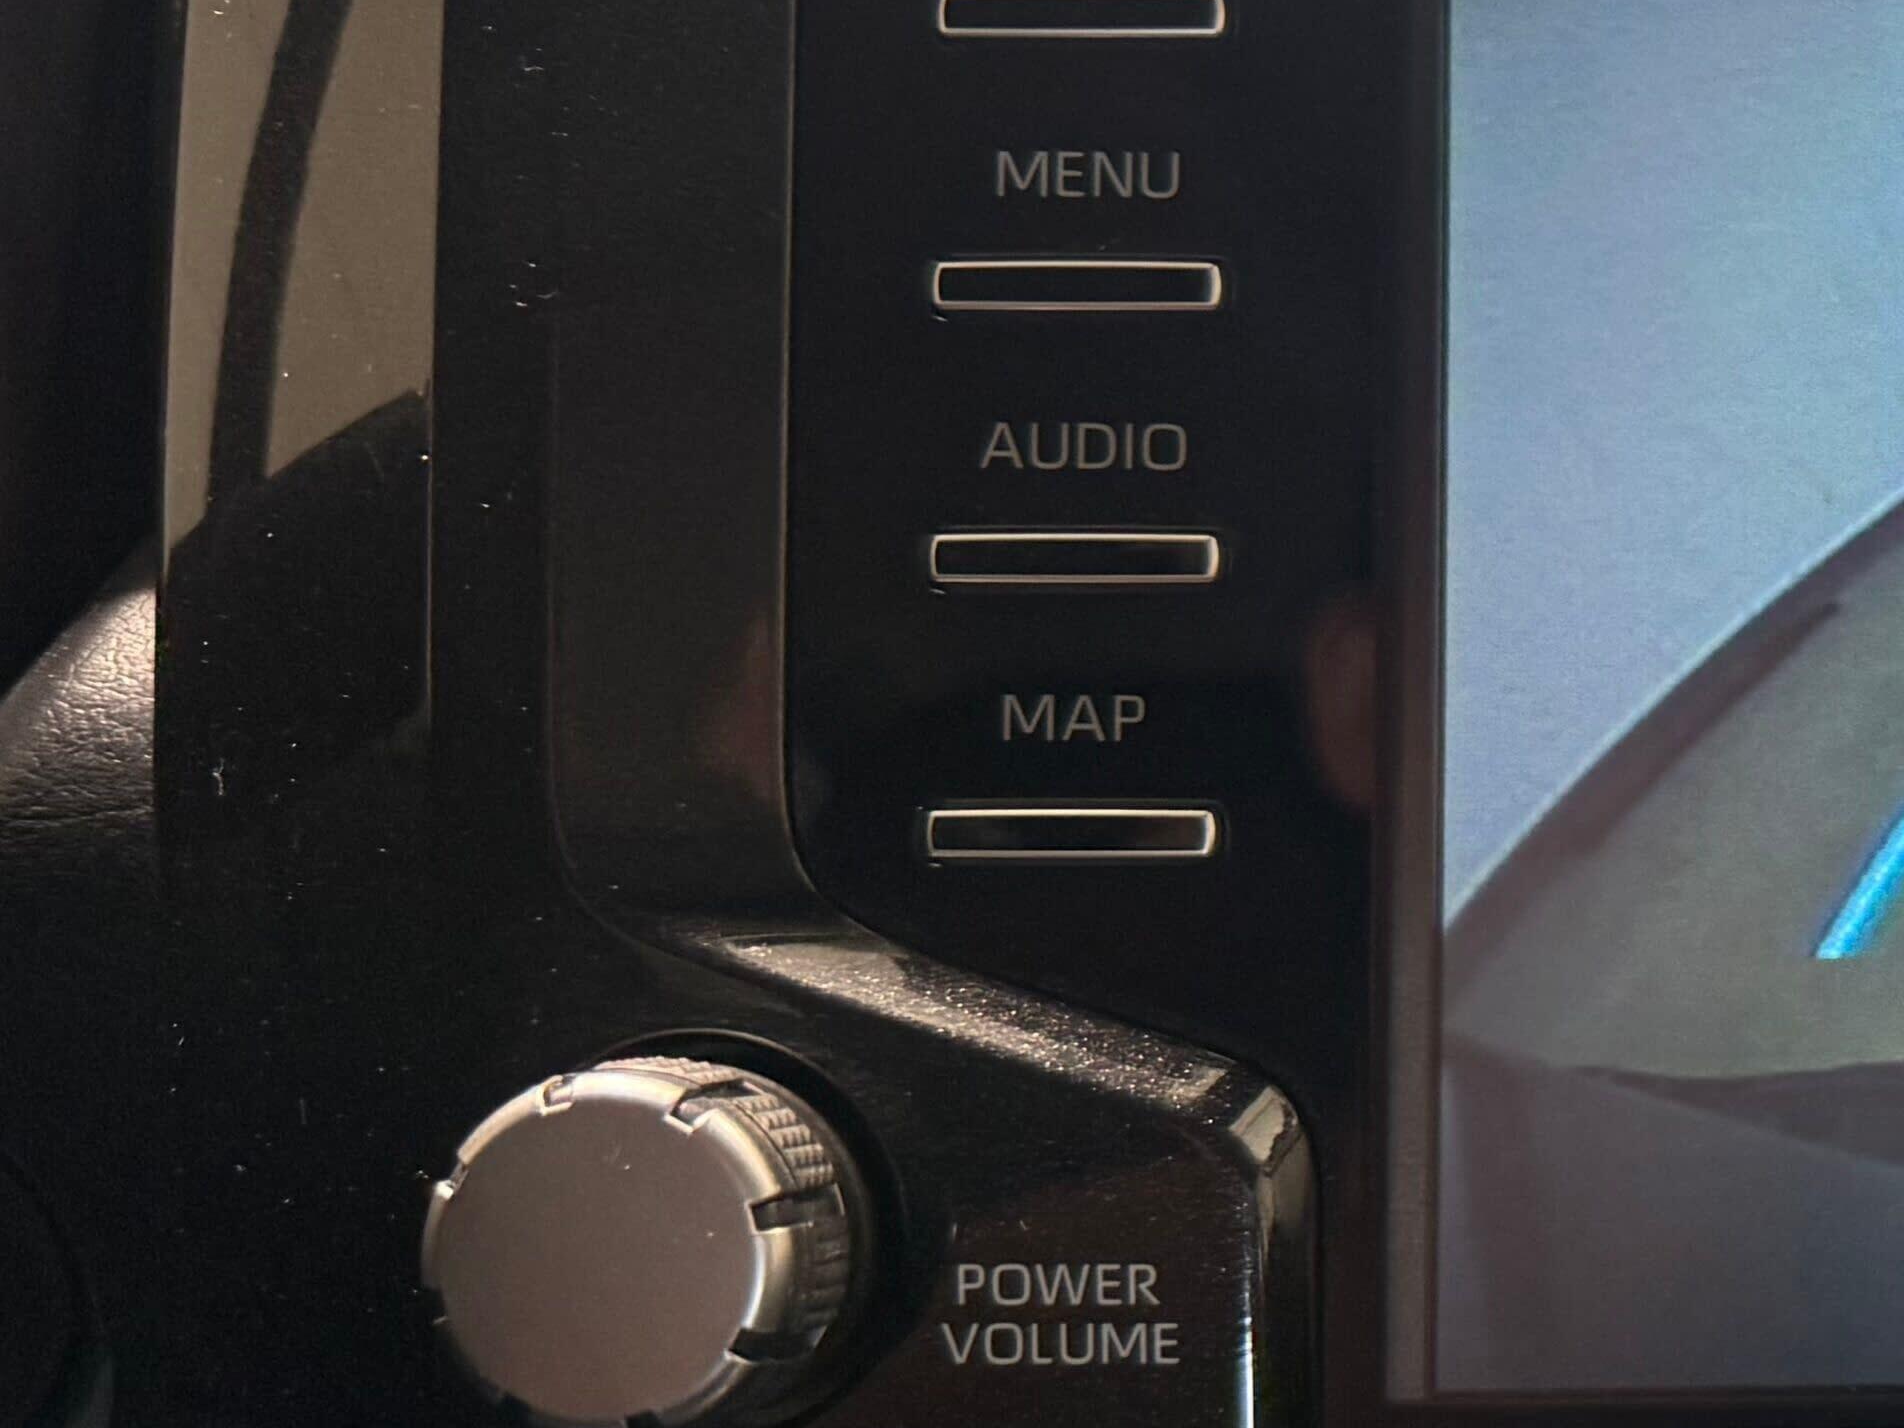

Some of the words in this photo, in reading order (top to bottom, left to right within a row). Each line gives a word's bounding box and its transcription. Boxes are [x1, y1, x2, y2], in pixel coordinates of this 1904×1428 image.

[997, 151, 1181, 200] MENU
[981, 422, 1188, 471] AUDIO
[1003, 694, 1146, 741] MAP
[957, 1263, 1160, 1307] POWER
[941, 1322, 1181, 1365] VOLUME
